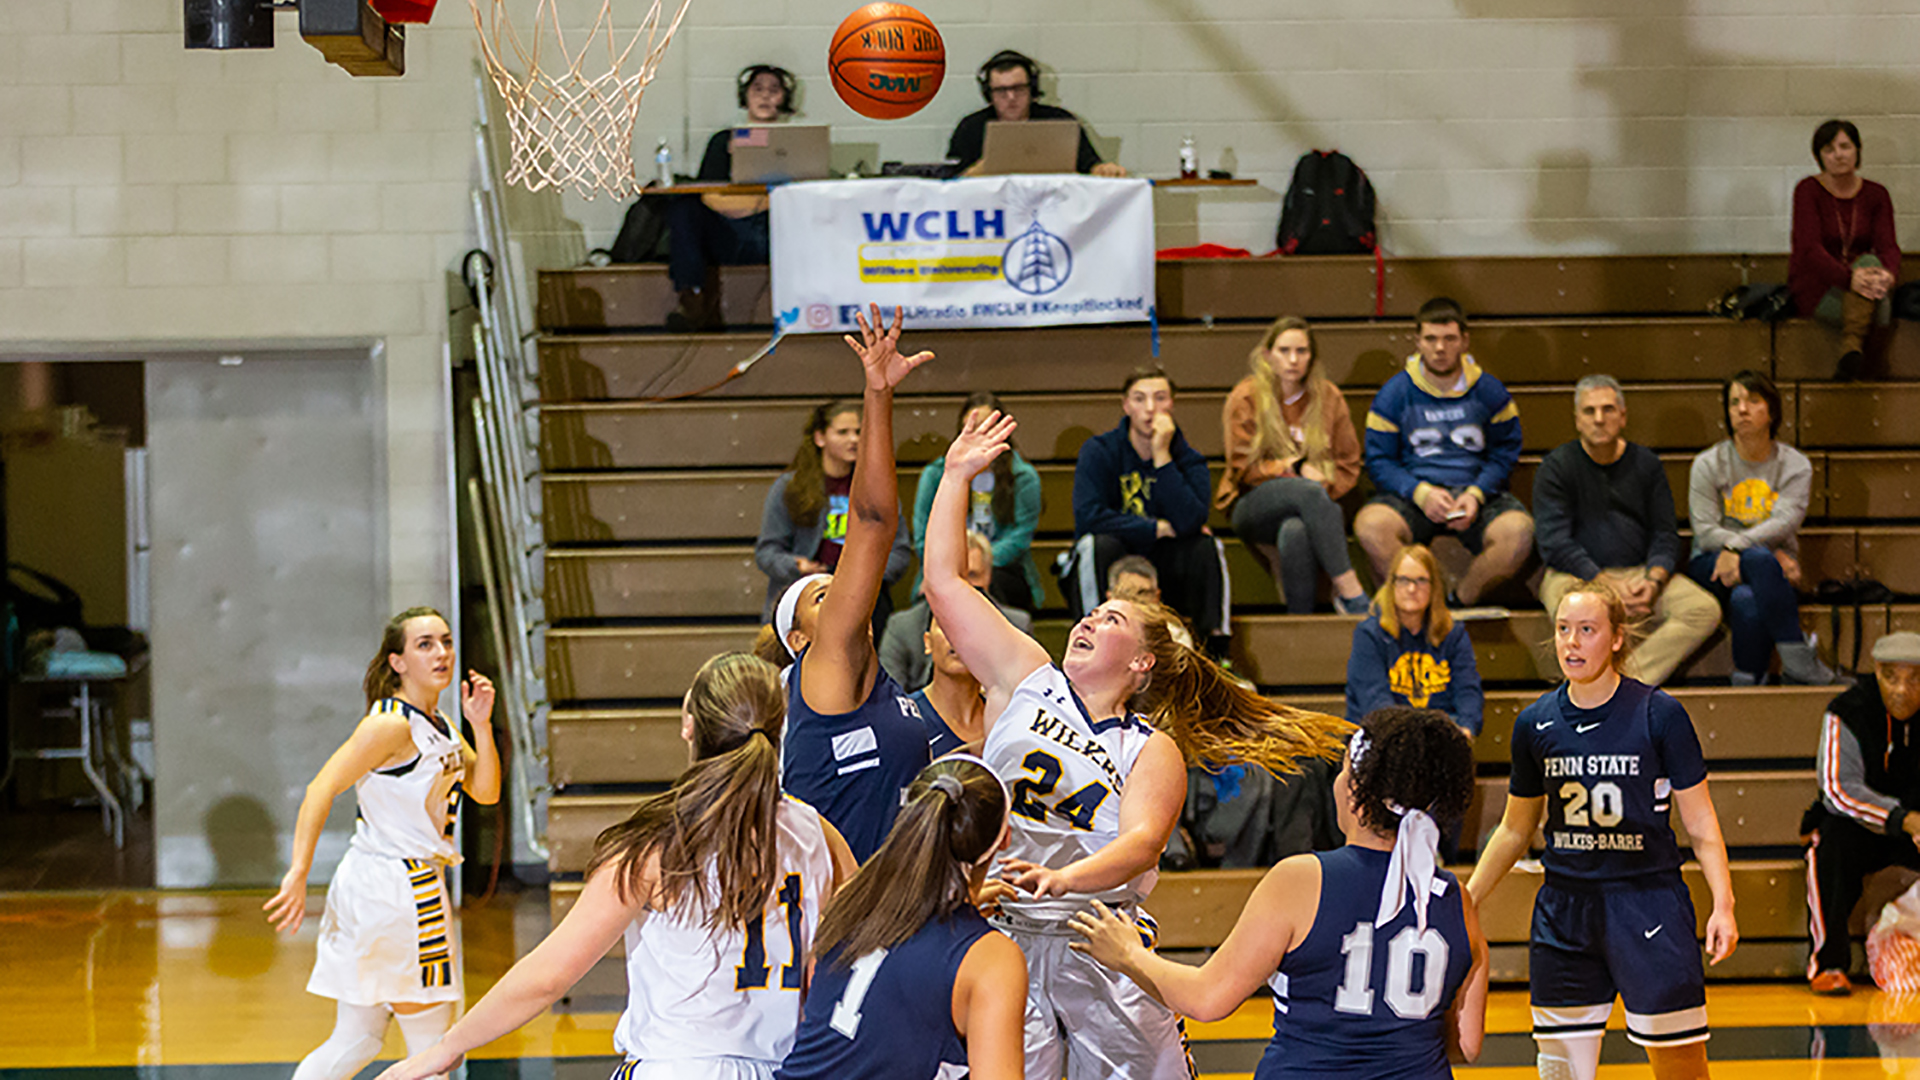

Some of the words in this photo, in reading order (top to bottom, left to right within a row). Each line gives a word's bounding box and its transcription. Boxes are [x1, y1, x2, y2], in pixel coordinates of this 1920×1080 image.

[911, 28, 939, 51] THE
[868, 73, 921, 93] MAC
[862, 209, 1005, 241] WCLH
[1544, 755, 1583, 777] PENN
[1587, 755, 1640, 775] STATE
[1010, 748, 1112, 832] 24
[1558, 781, 1623, 827] 20
[1553, 832, 1644, 851] WILKES-BARRE
[734, 871, 804, 992] 11
[1334, 921, 1450, 1020] 10
[829, 946, 889, 1040] 1
